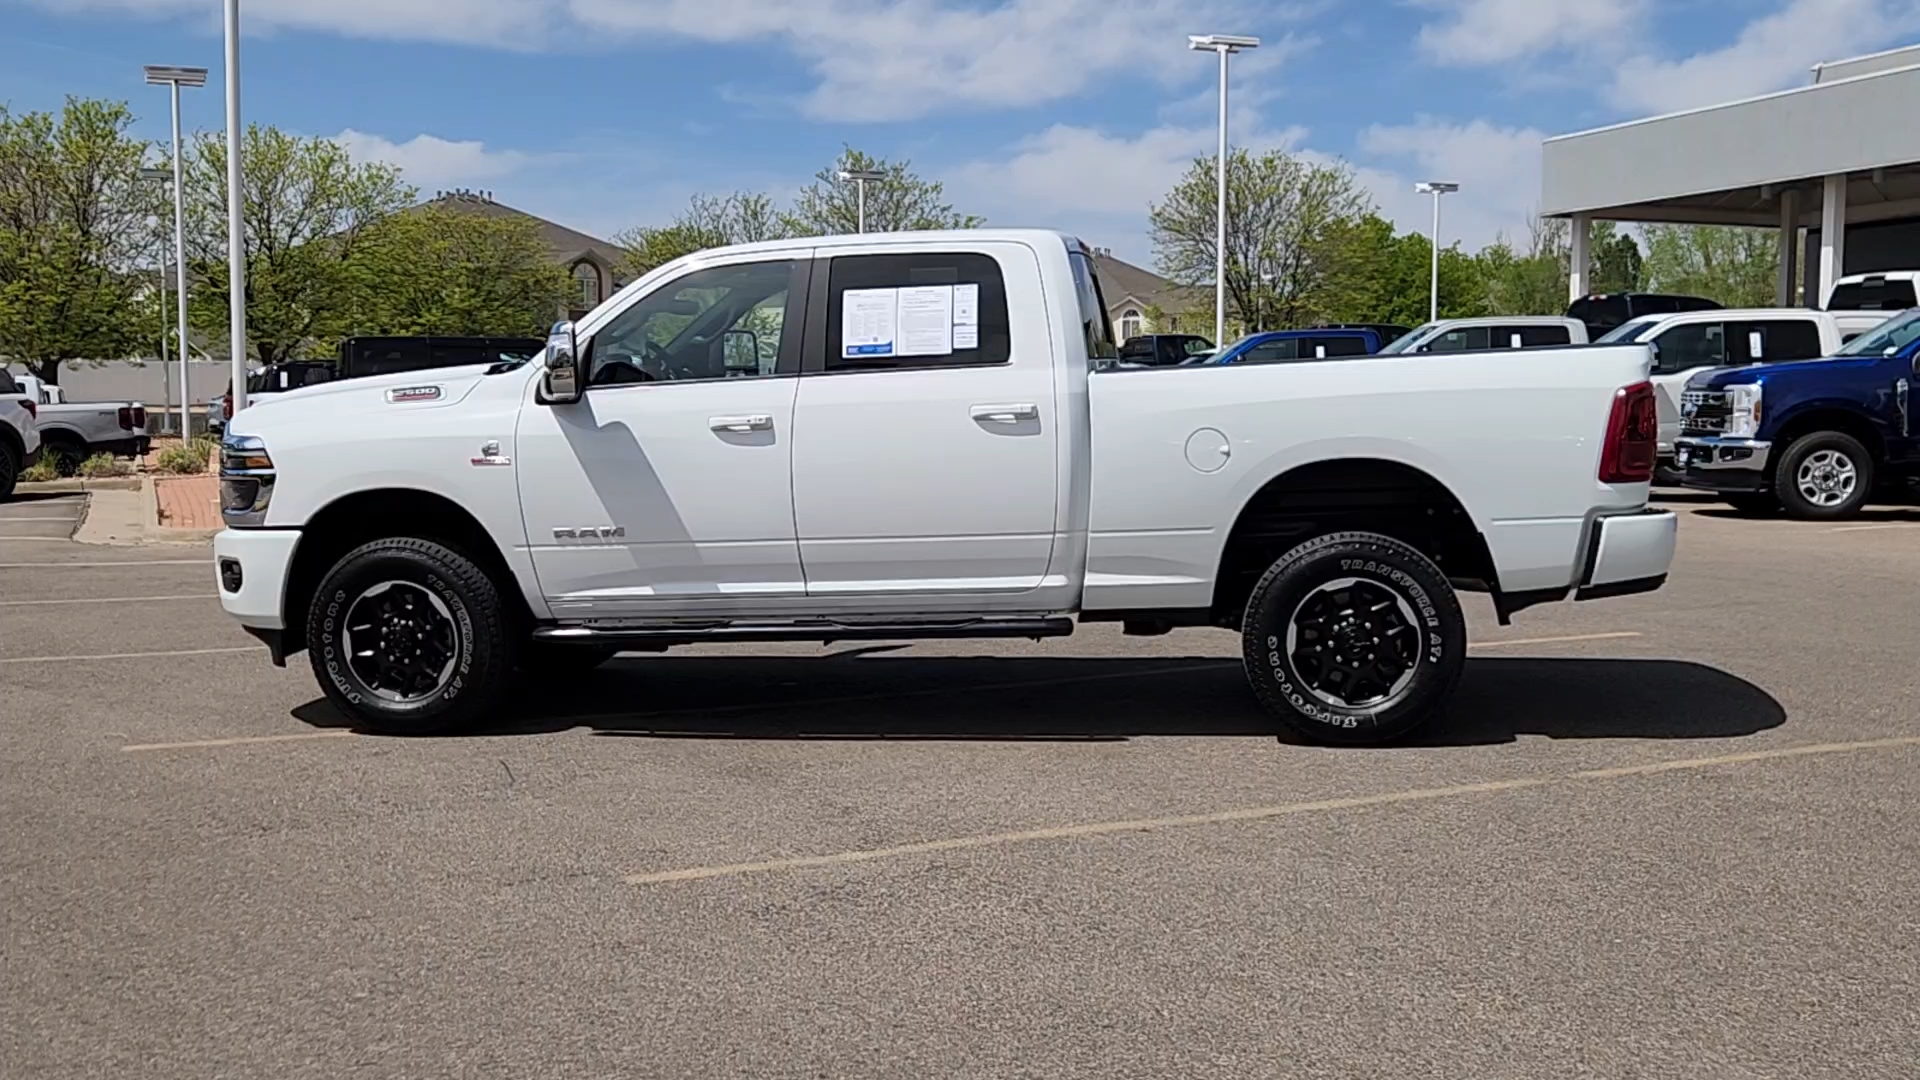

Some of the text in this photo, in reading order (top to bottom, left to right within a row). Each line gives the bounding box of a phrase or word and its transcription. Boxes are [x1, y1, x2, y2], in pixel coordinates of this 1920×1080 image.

[391, 387, 437, 398] 2500
[552, 526, 625, 541] RAM
[1340, 559, 1440, 628] TRANSFORCE
[428, 574, 473, 674] TRANSFORCE
